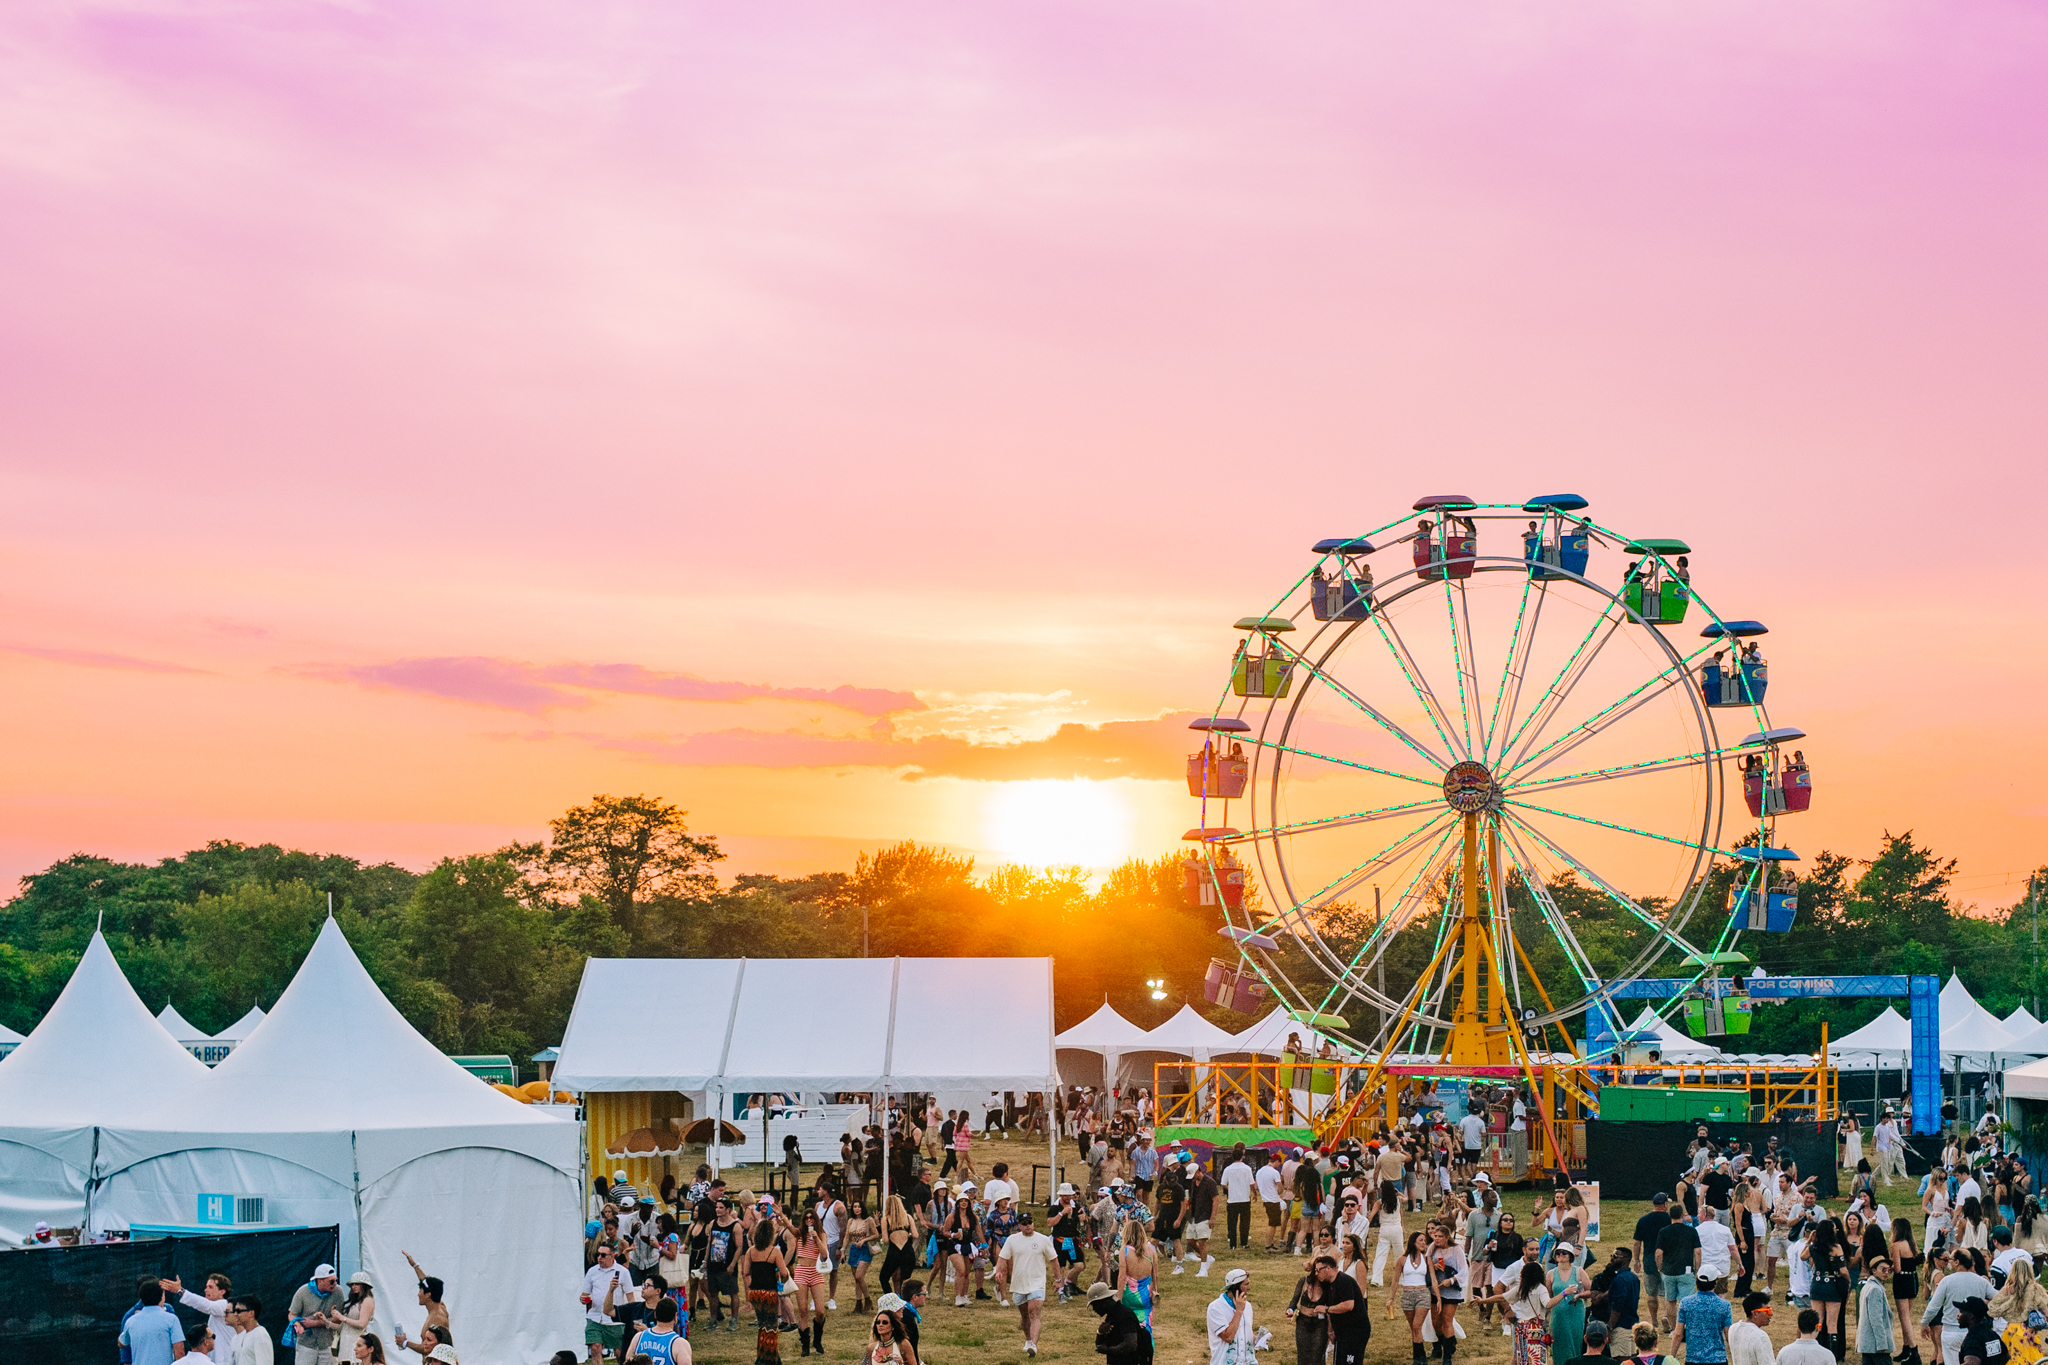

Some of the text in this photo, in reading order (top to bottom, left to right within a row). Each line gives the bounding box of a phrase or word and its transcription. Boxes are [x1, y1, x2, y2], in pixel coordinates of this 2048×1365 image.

[1451, 767, 1487, 782] WNDERLAND
[1748, 980, 1776, 989] FOR
[1779, 979, 1834, 989] COMING
[204, 1046, 230, 1062] BEER
[1433, 1067, 1473, 1075] ENTRANCE
[208, 1197, 222, 1217] HI
[640, 1341, 667, 1354] JORDAN
